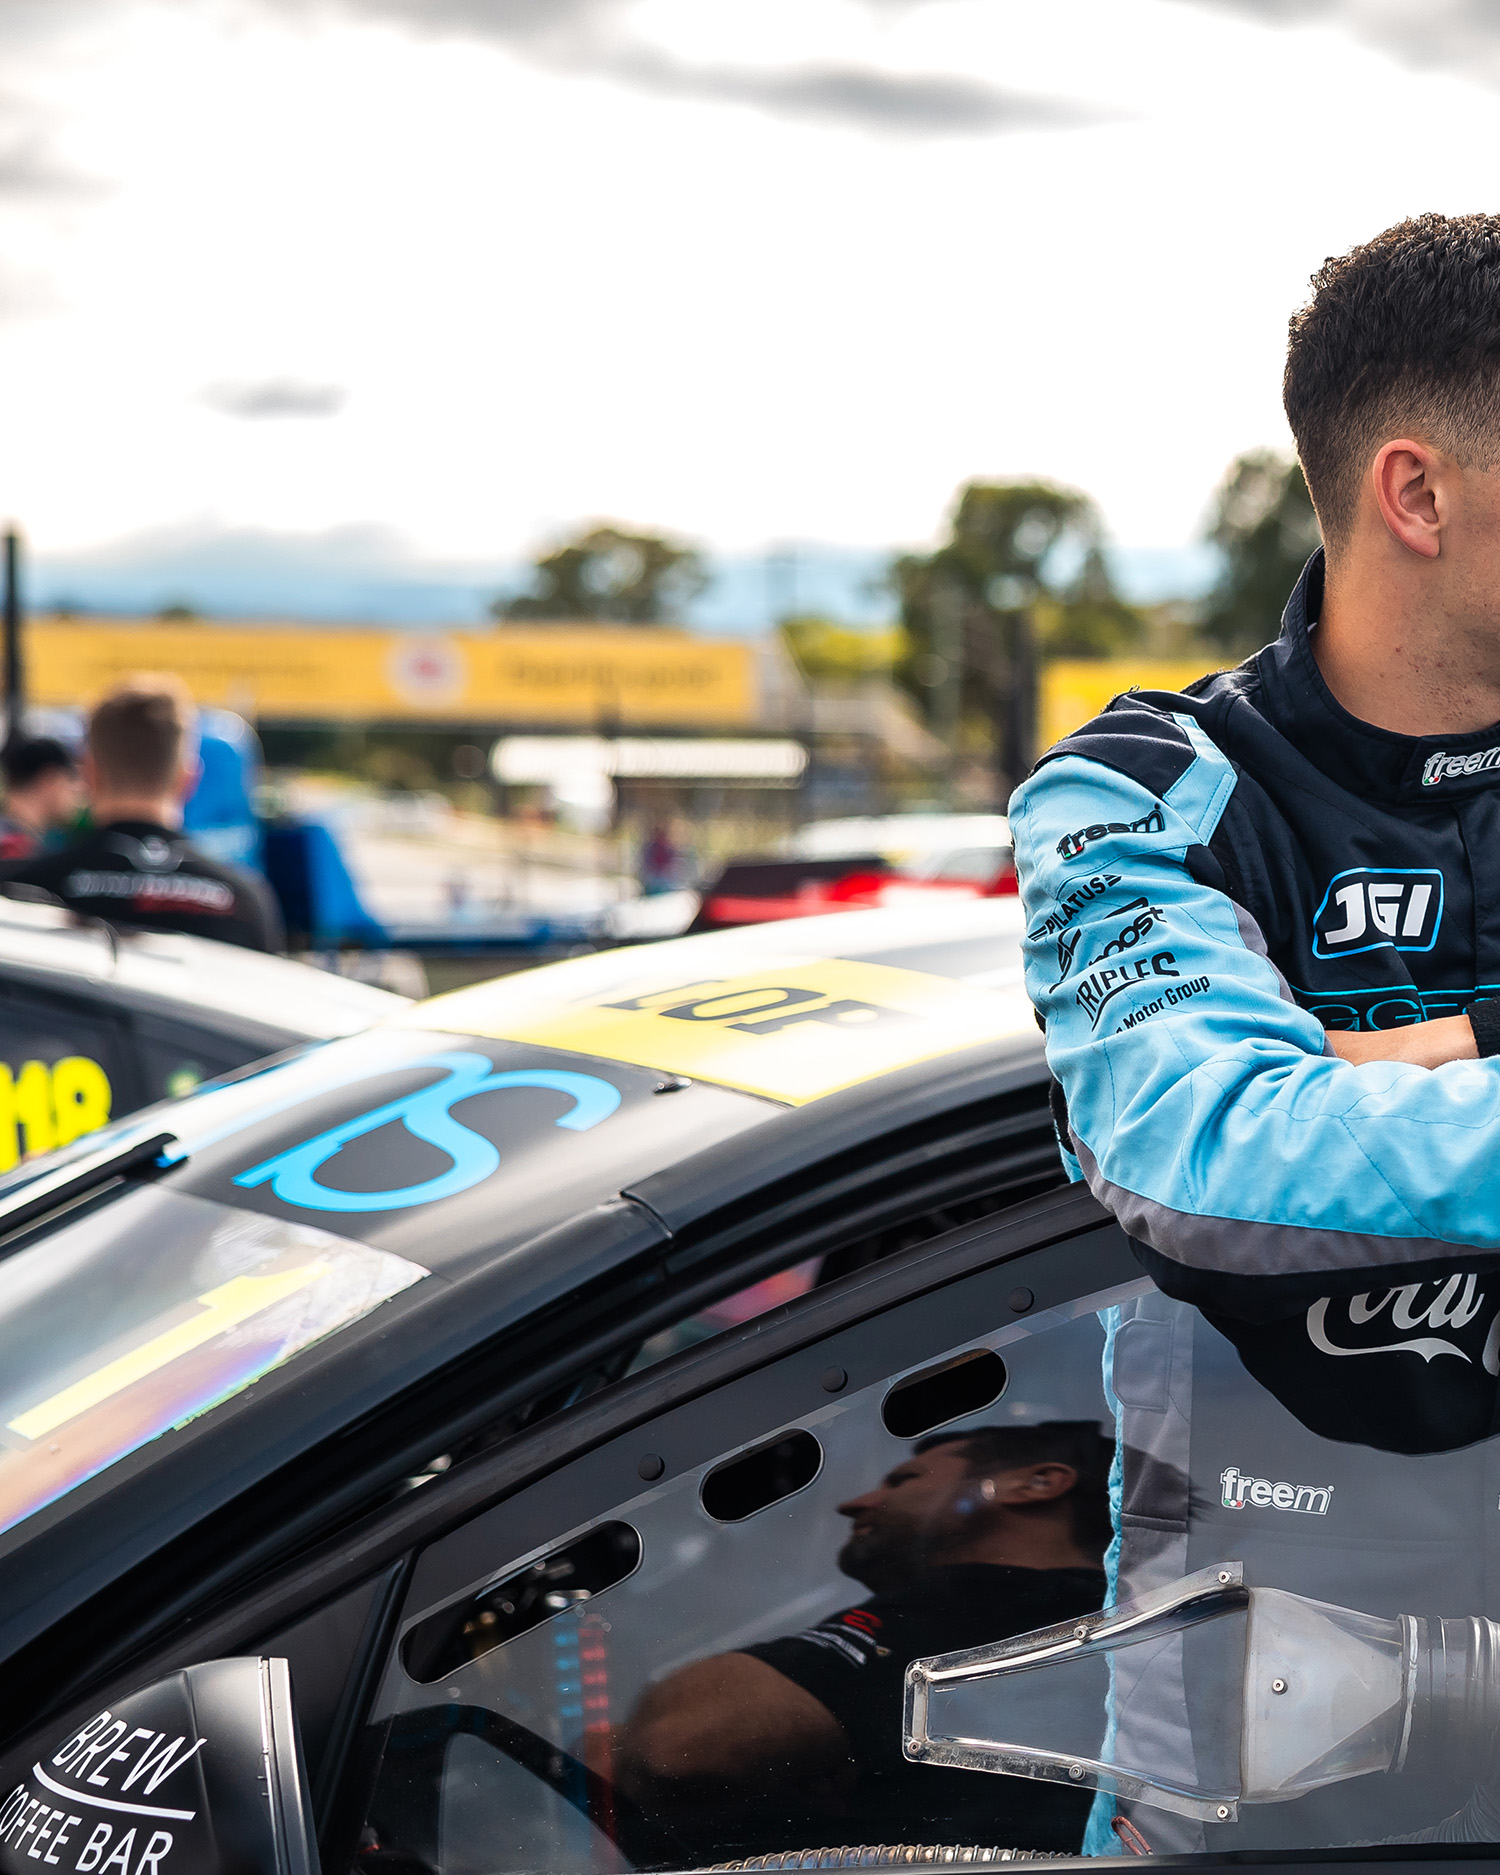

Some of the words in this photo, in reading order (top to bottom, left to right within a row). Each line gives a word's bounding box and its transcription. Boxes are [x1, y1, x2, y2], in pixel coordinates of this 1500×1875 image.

[1056, 806, 1166, 860] freem
[1045, 876, 1106, 934] PILATUS
[1325, 882, 1433, 945] JGI
[1122, 997, 1165, 1029] Motor
[1164, 975, 1211, 1006] Group
[1220, 1466, 1334, 1516] freem
[51, 1710, 208, 1795] BREW
[74, 1822, 174, 1875] BAR
